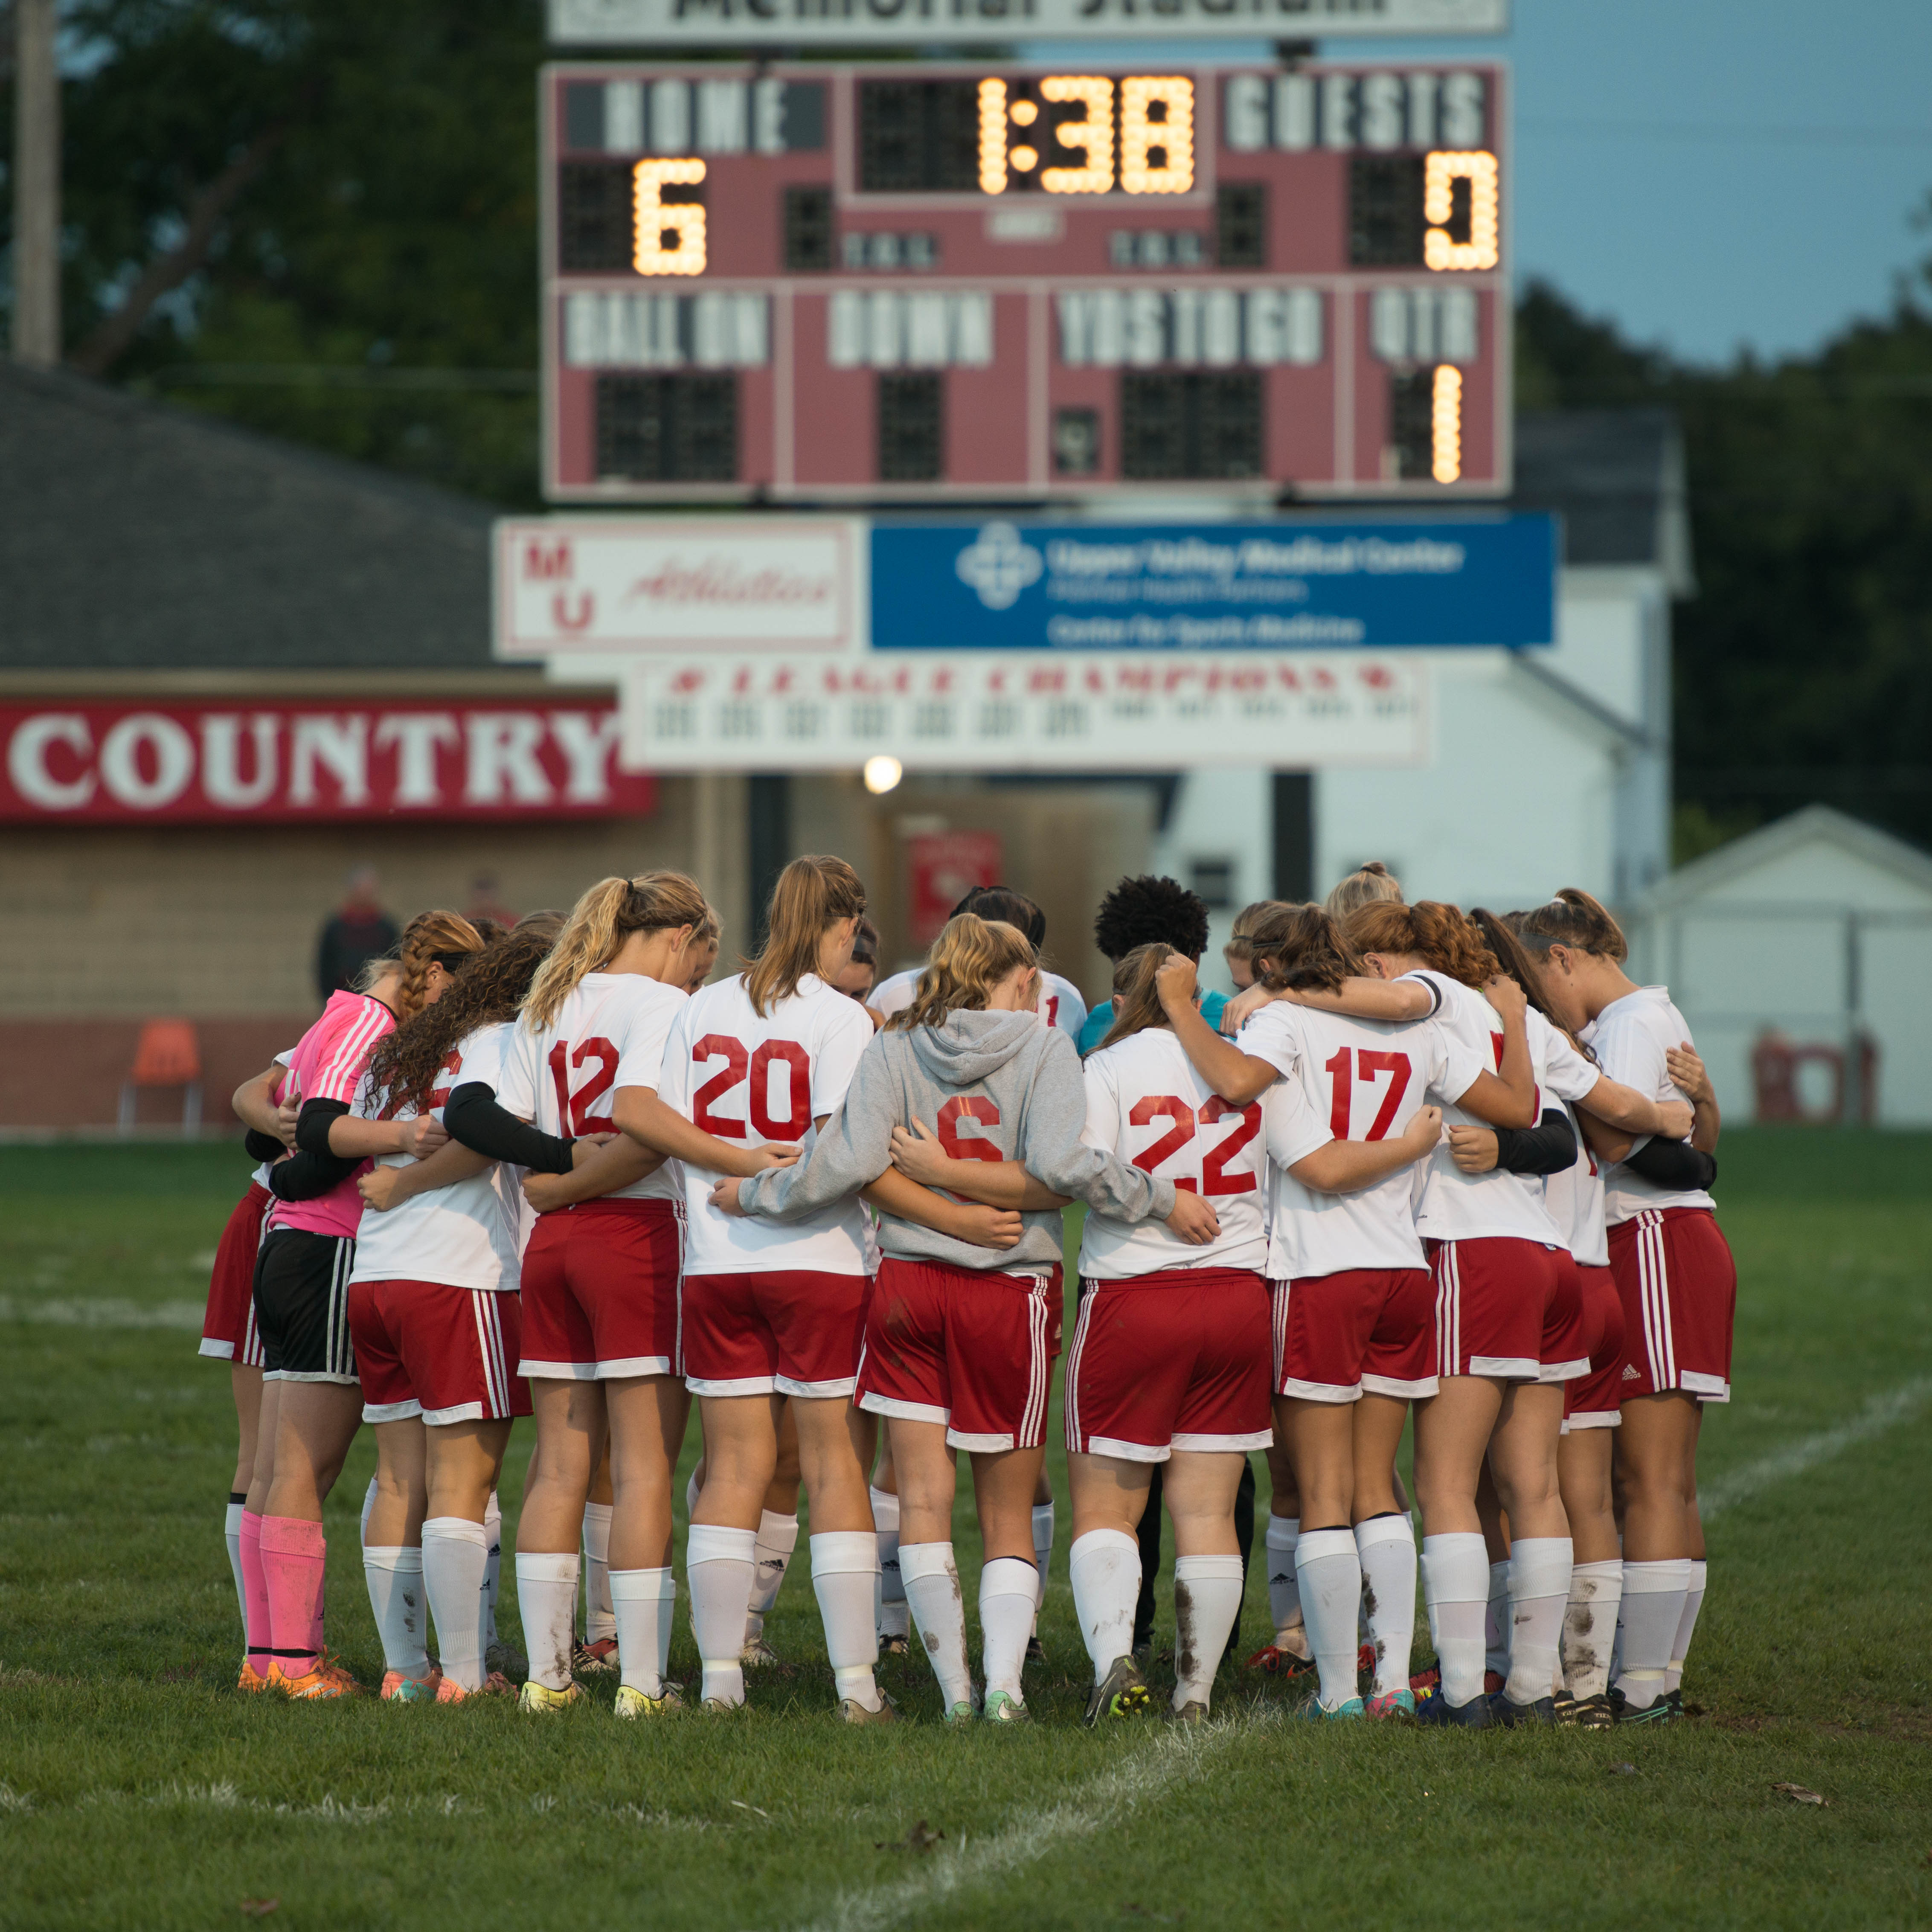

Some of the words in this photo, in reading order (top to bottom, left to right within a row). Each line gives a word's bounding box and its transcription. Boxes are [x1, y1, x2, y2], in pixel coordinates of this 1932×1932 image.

[979, 76, 1194, 195] 1:38
[1226, 73, 1483, 150] GUESTS
[634, 158, 706, 276] 6
[1432, 364, 1461, 483] 1
[1238, 539, 1359, 572] Medical
[1363, 539, 1462, 572] Center
[7, 712, 622, 810] COUNTRY
[548, 1037, 619, 1138] 12
[692, 1034, 812, 1142] 20
[1325, 1046, 1412, 1141] 17
[1129, 1094, 1263, 1196] 22
